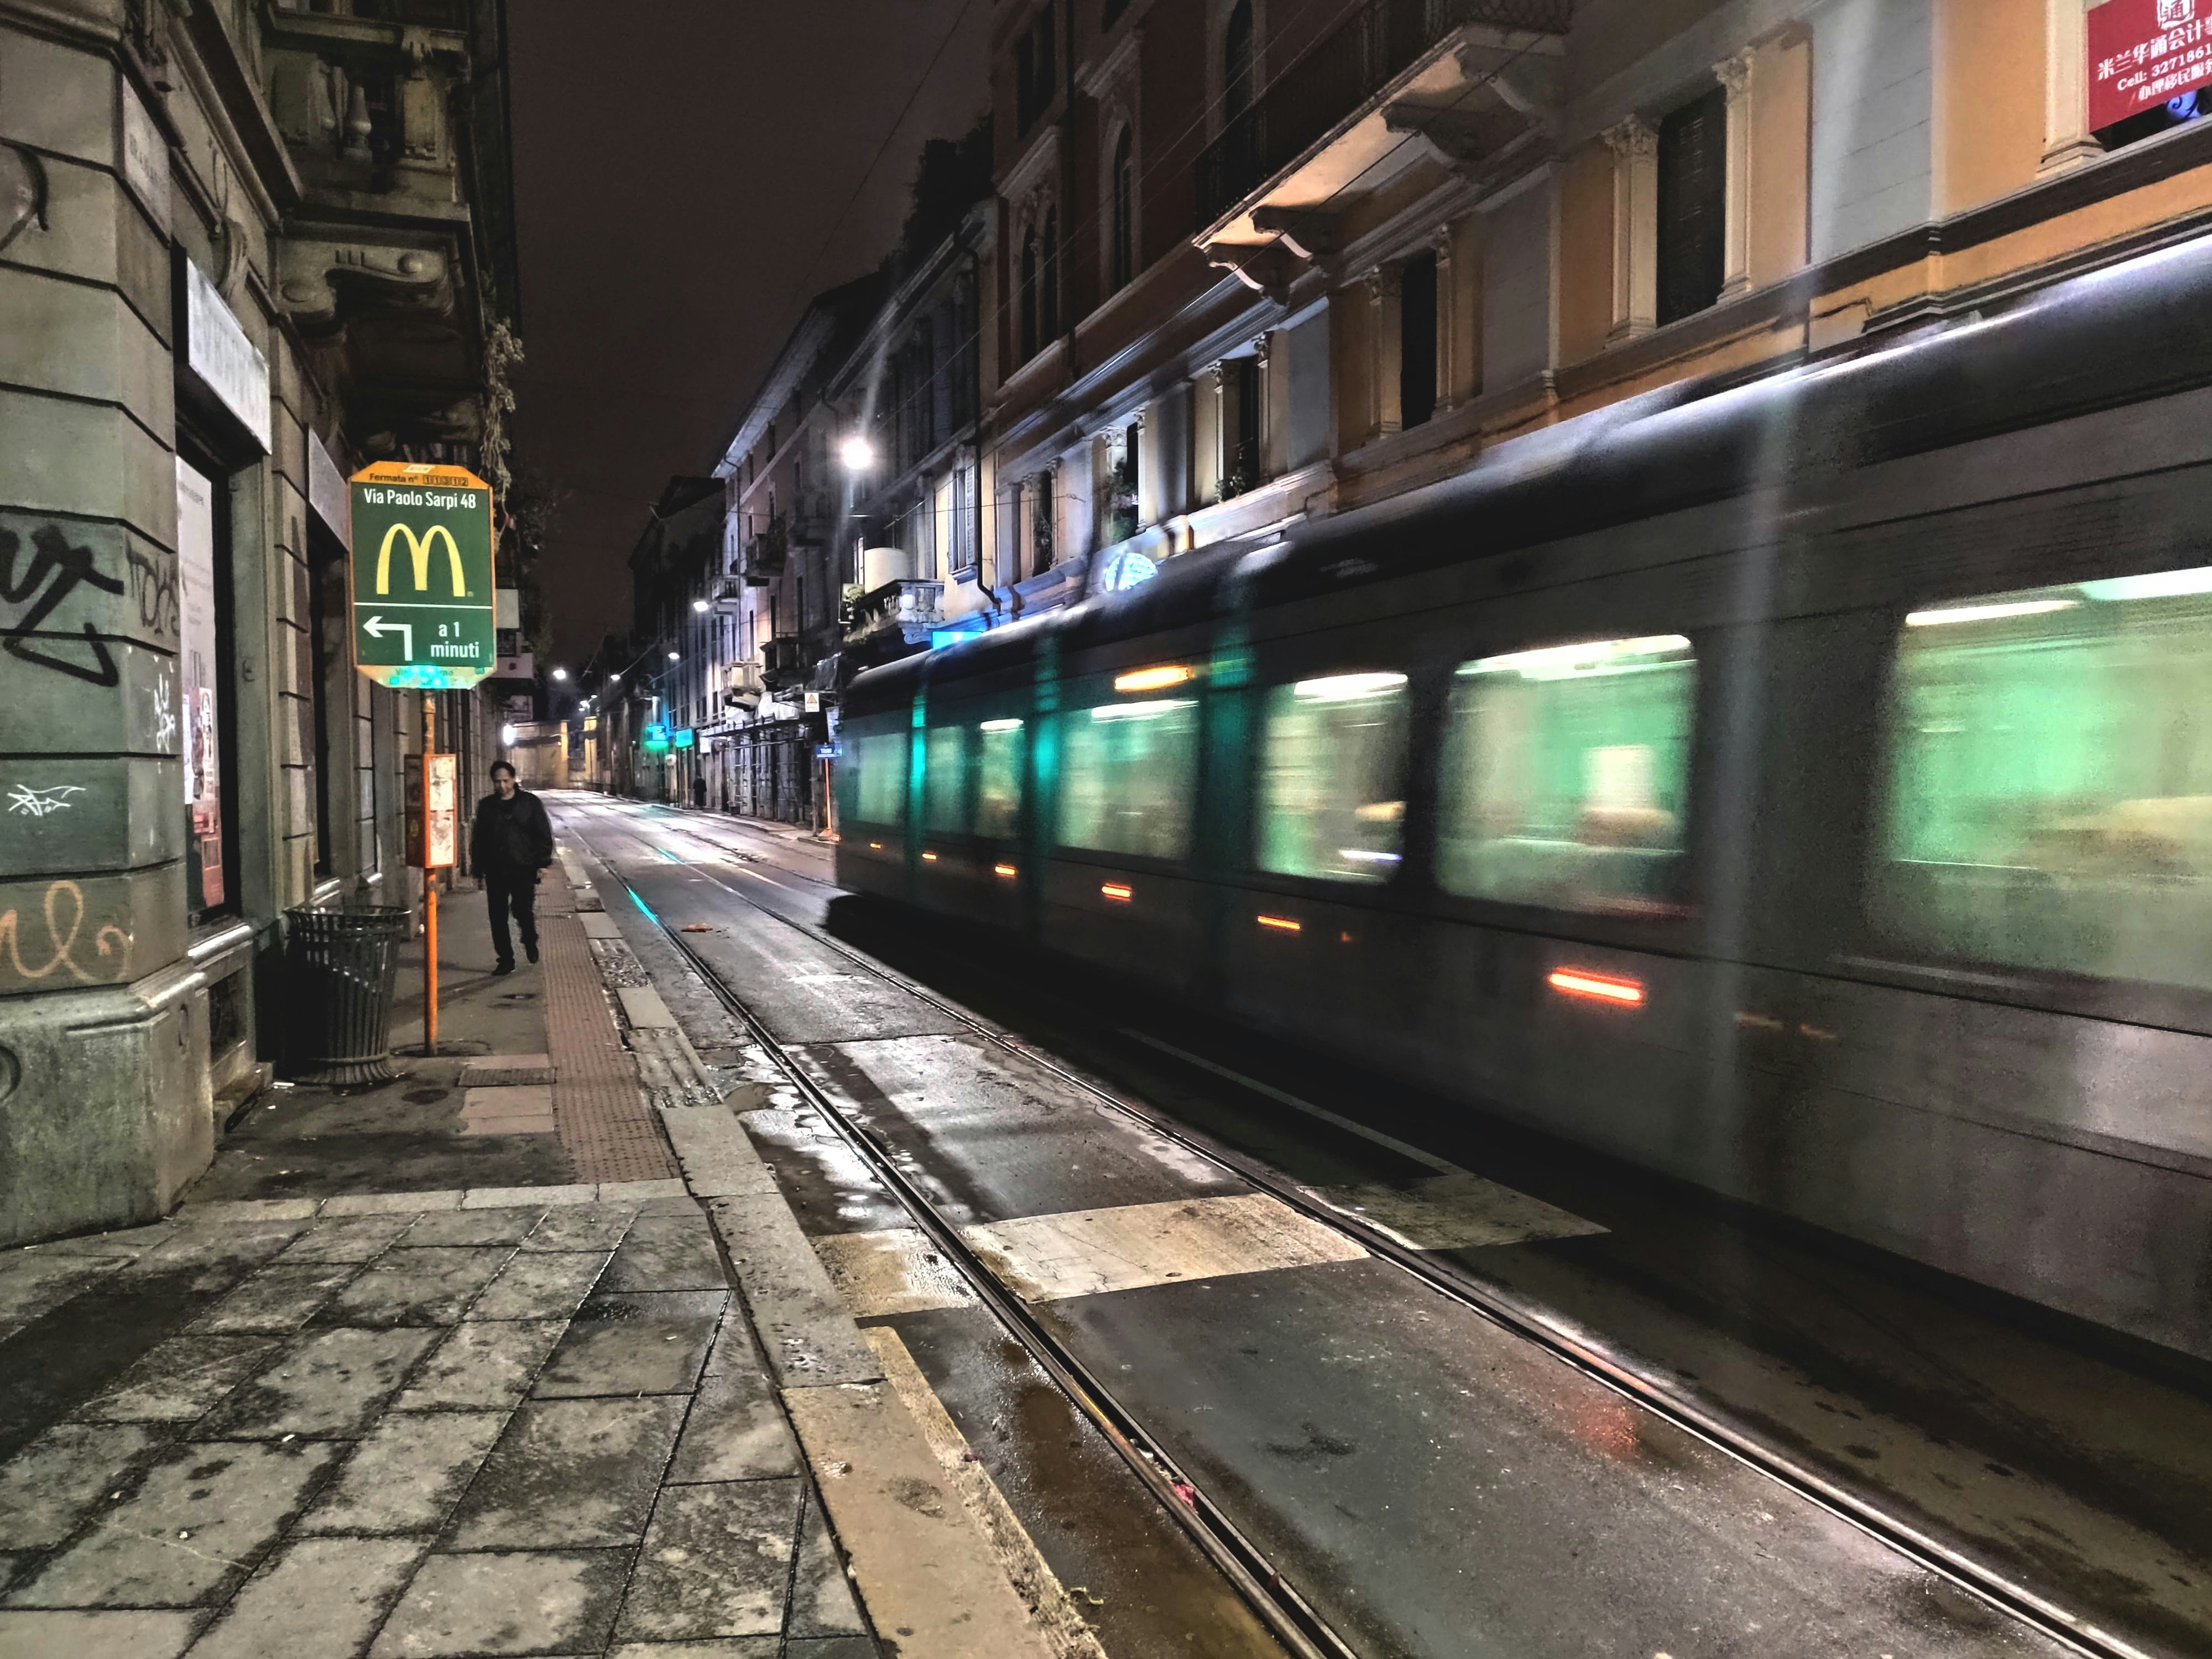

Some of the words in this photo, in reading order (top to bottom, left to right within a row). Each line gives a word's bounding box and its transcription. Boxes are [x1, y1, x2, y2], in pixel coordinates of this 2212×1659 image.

[369, 473, 406, 483] Fermata
[364, 488, 384, 504] Via
[387, 489, 422, 506] Paolo
[425, 492, 457, 510] Sarpi
[460, 493, 476, 509] 48
[439, 624, 447, 637] a
[453, 622, 460, 638] 1
[431, 641, 479, 658] minuti
